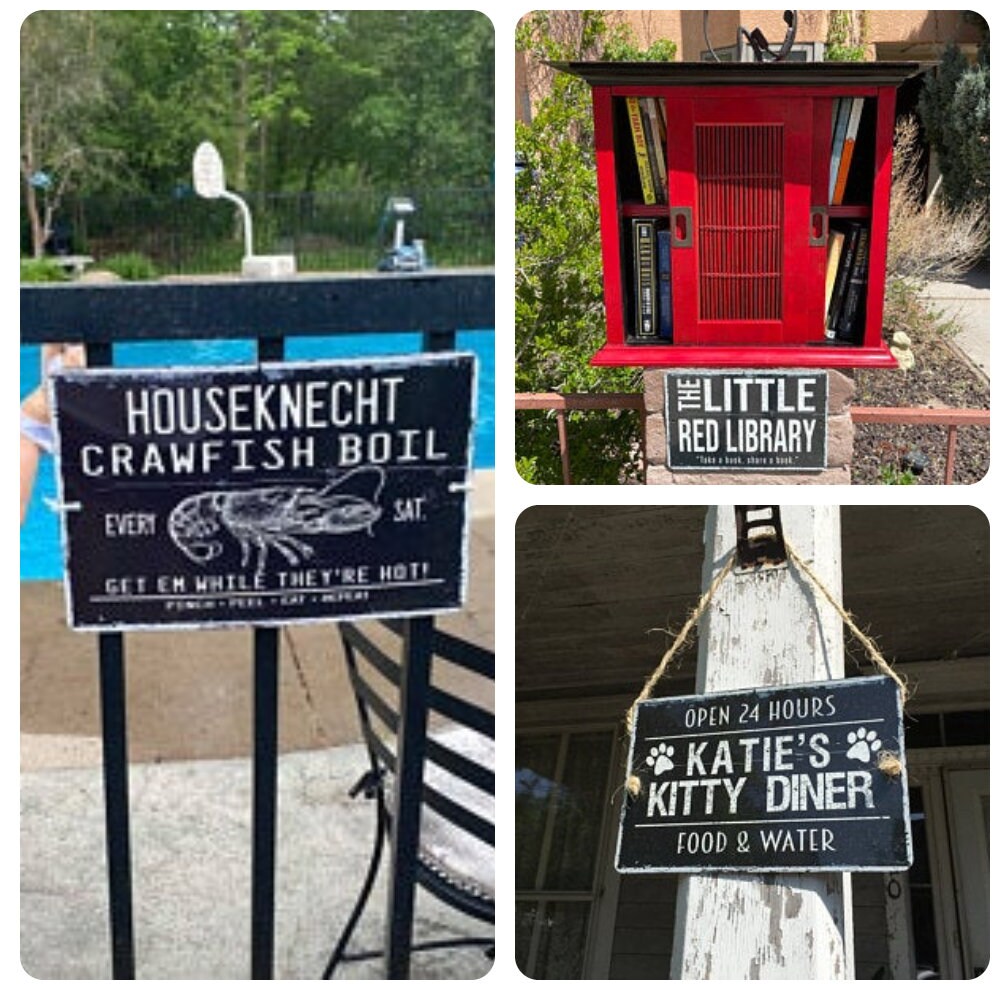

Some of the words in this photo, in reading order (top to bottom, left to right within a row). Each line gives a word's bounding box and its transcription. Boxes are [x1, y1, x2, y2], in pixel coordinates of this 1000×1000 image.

[126, 378, 404, 435] HOUSEKNECHT
[677, 378, 701, 412] THE
[703, 378, 816, 412] LITTLE
[678, 418, 719, 452] RED
[726, 418, 816, 452] LIBRARY
[81, 436, 315, 477] CRAWFISH
[338, 428, 448, 466] BOIL
[105, 513, 157, 537] EVERY
[392, 499, 427, 522] SAT.
[105, 577, 147, 595] GET
[157, 575, 185, 593] EM
[195, 573, 266, 592] WHILE
[279, 565, 369, 587] THEY'RE
[380, 562, 431, 581] HOT!
[685, 704, 730, 728] OPEN
[739, 703, 759, 723] 24
[769, 695, 836, 721] HOURS
[686, 732, 831, 777] KATIE'S
[646, 776, 747, 817] KITTY
[766, 770, 875, 813] DINER
[677, 831, 727, 854] FOOD
[737, 832, 750, 853] &
[760, 829, 836, 852] WATER
